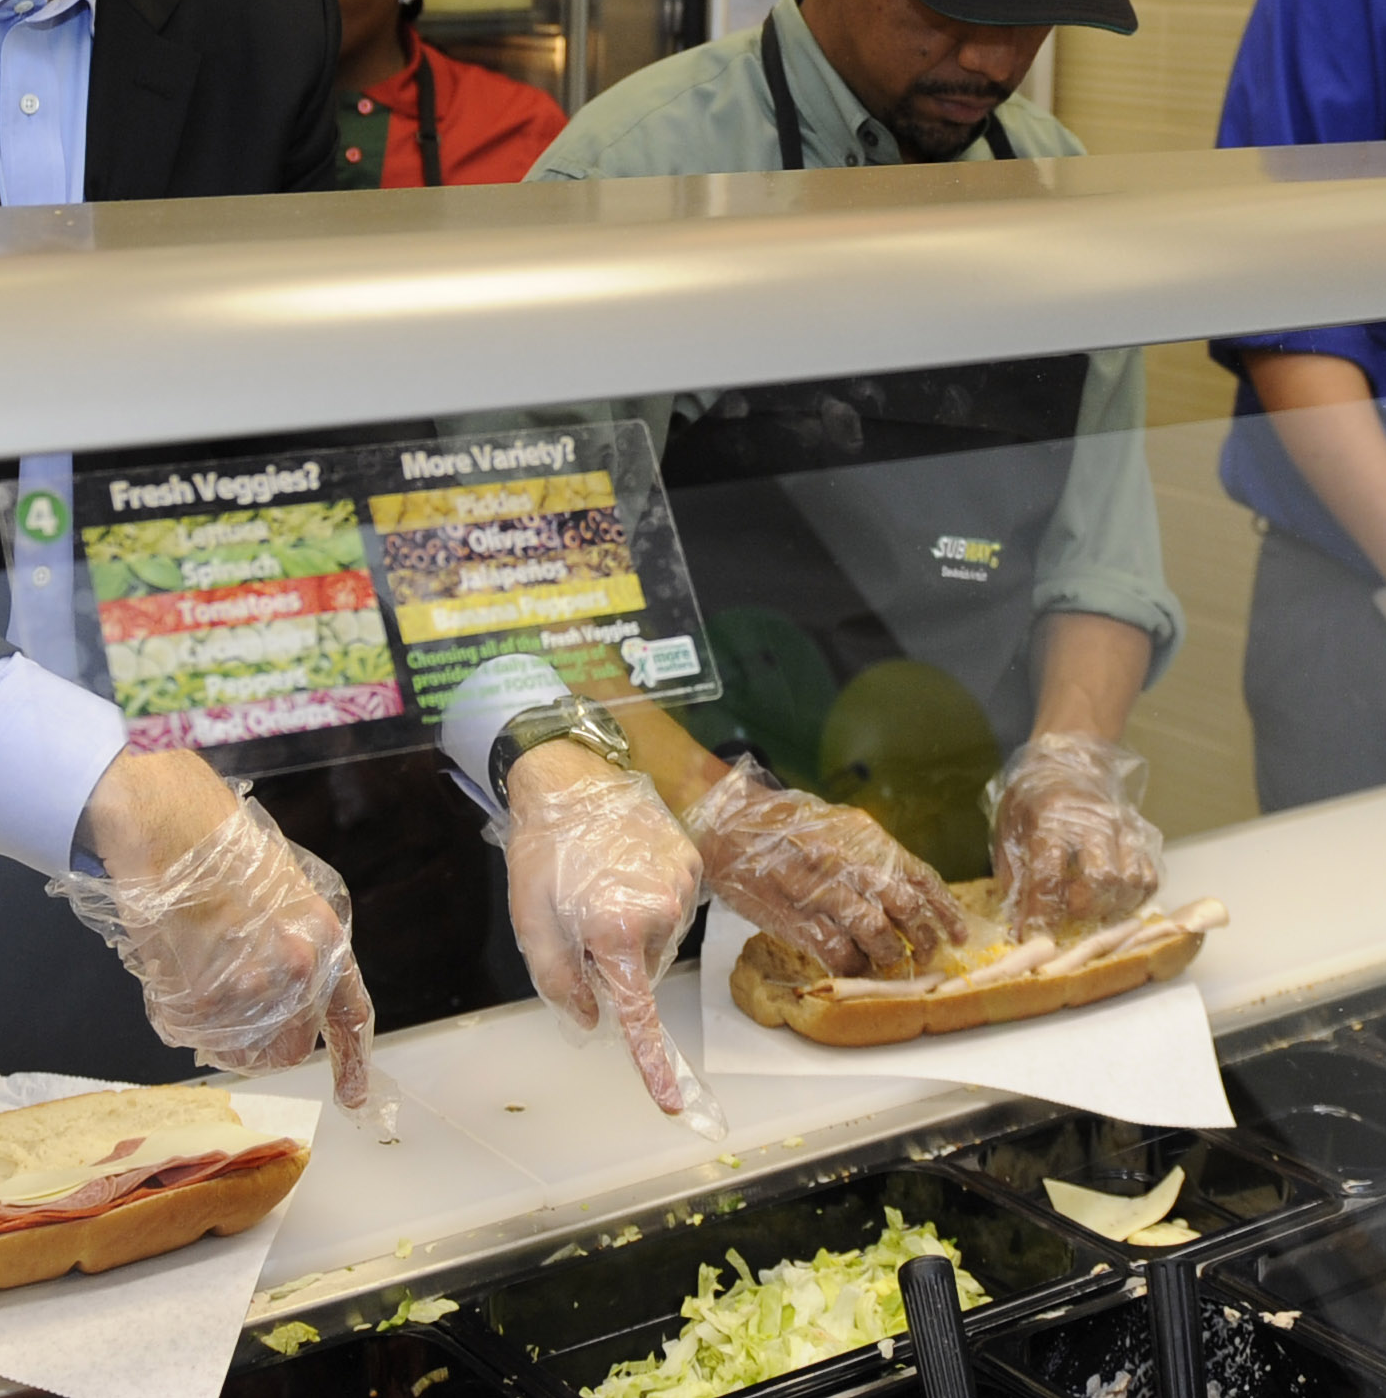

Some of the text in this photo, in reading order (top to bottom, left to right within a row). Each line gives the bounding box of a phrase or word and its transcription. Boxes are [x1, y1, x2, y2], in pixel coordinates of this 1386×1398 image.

[400, 435, 577, 481] More Variety?
[109, 461, 322, 512] Fresh Veggies?
[25, 497, 60, 537] 4
[467, 523, 540, 554] Olives
[180, 552, 283, 590] Spinach
[177, 590, 303, 624] Tomatoes
[540, 627, 581, 650] Fresh
[581, 618, 640, 645] Veggies
